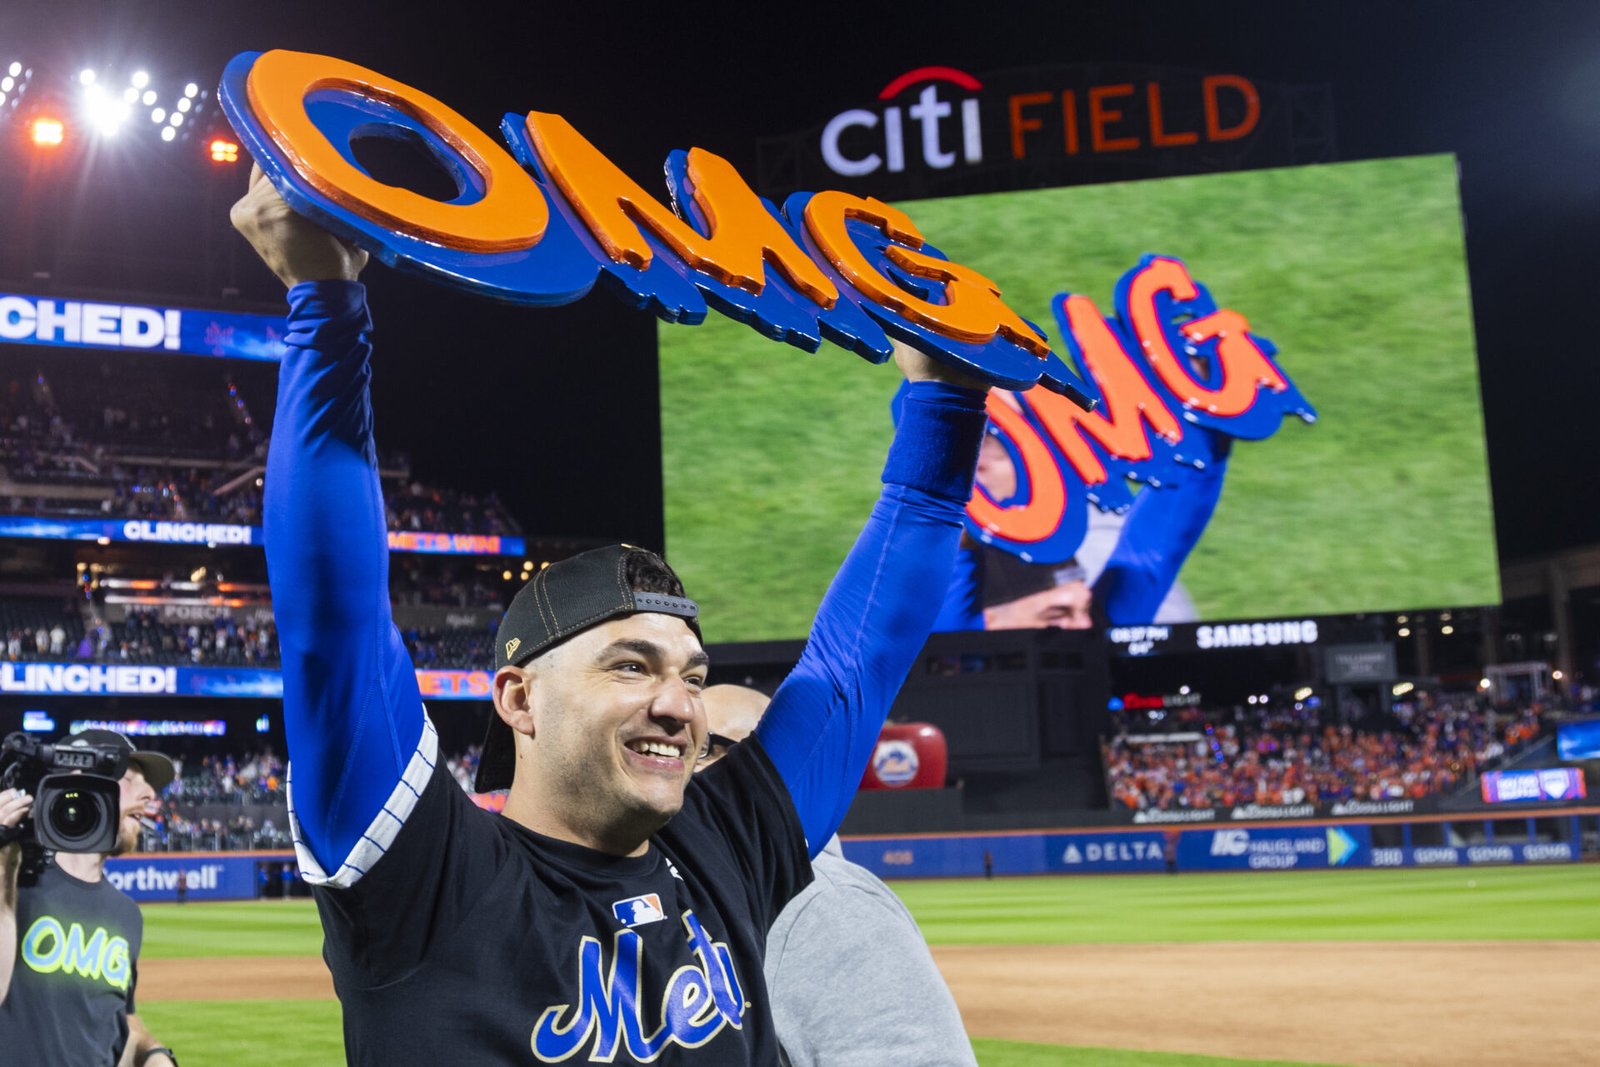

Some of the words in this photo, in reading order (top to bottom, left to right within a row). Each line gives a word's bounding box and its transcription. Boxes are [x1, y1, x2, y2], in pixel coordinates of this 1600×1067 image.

[1008, 74, 1261, 160] FIELD
[217, 48, 1098, 410] OMG
[123, 520, 252, 545] CLINCHED!
[1196, 620, 1319, 649] SAMSUNG
[0, 663, 178, 694] LINCHED!
[1085, 841, 1163, 862] DELTA
[103, 865, 217, 891] orthwell
[22, 916, 131, 991] OMG
